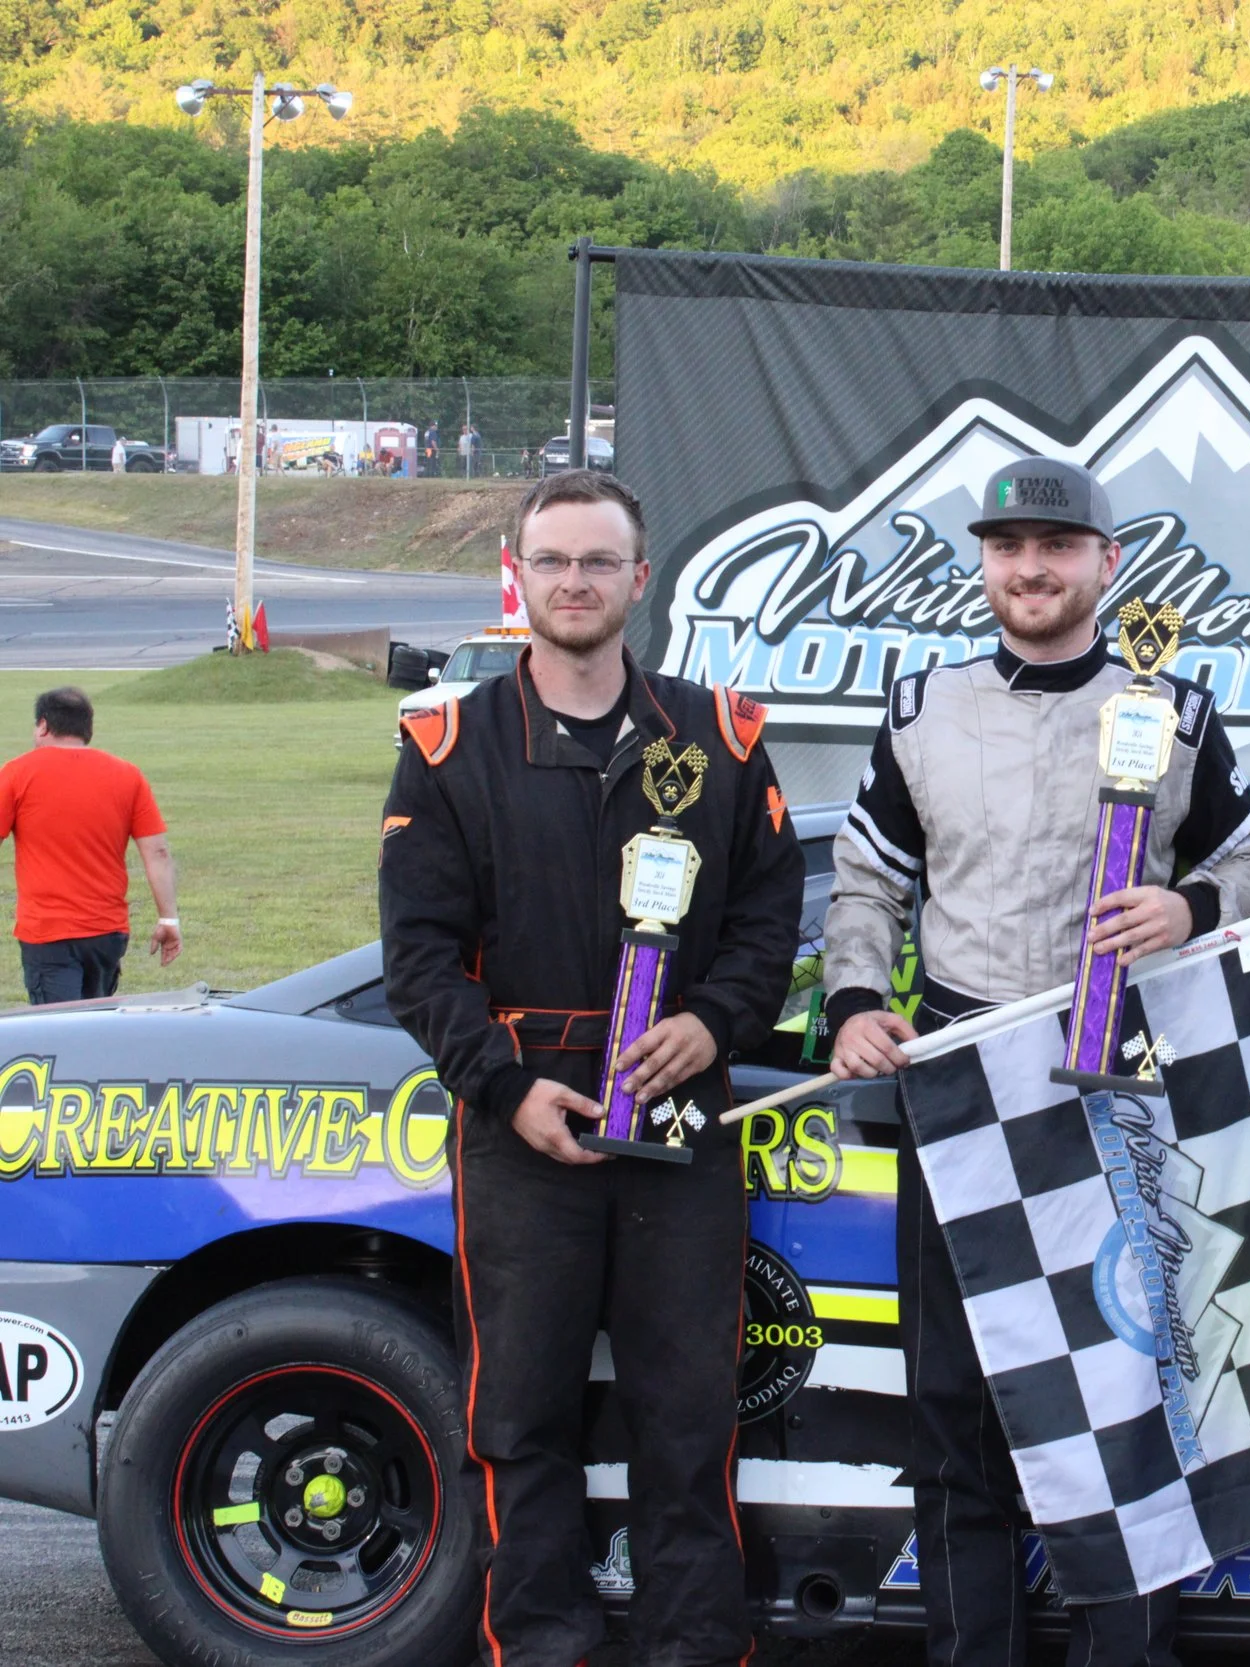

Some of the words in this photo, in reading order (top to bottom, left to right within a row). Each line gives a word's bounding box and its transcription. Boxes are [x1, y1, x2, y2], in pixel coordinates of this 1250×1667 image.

[1017, 478, 1064, 489] TWIN
[1019, 488, 1068, 498] STATE
[1020, 498, 1069, 508] FORD
[697, 513, 993, 640] White
[1111, 757, 1126, 768] 1st
[1127, 759, 1156, 771] Place
[632, 898, 650, 909] 3rd
[651, 900, 679, 913] Place
[0, 1057, 368, 1180] CREATIVE
[1111, 1091, 1167, 1207] White
[1148, 1213, 1201, 1382] Mountain
[1085, 1091, 1173, 1361] MOTORSPORTS
[1159, 1365, 1207, 1471] PARK
